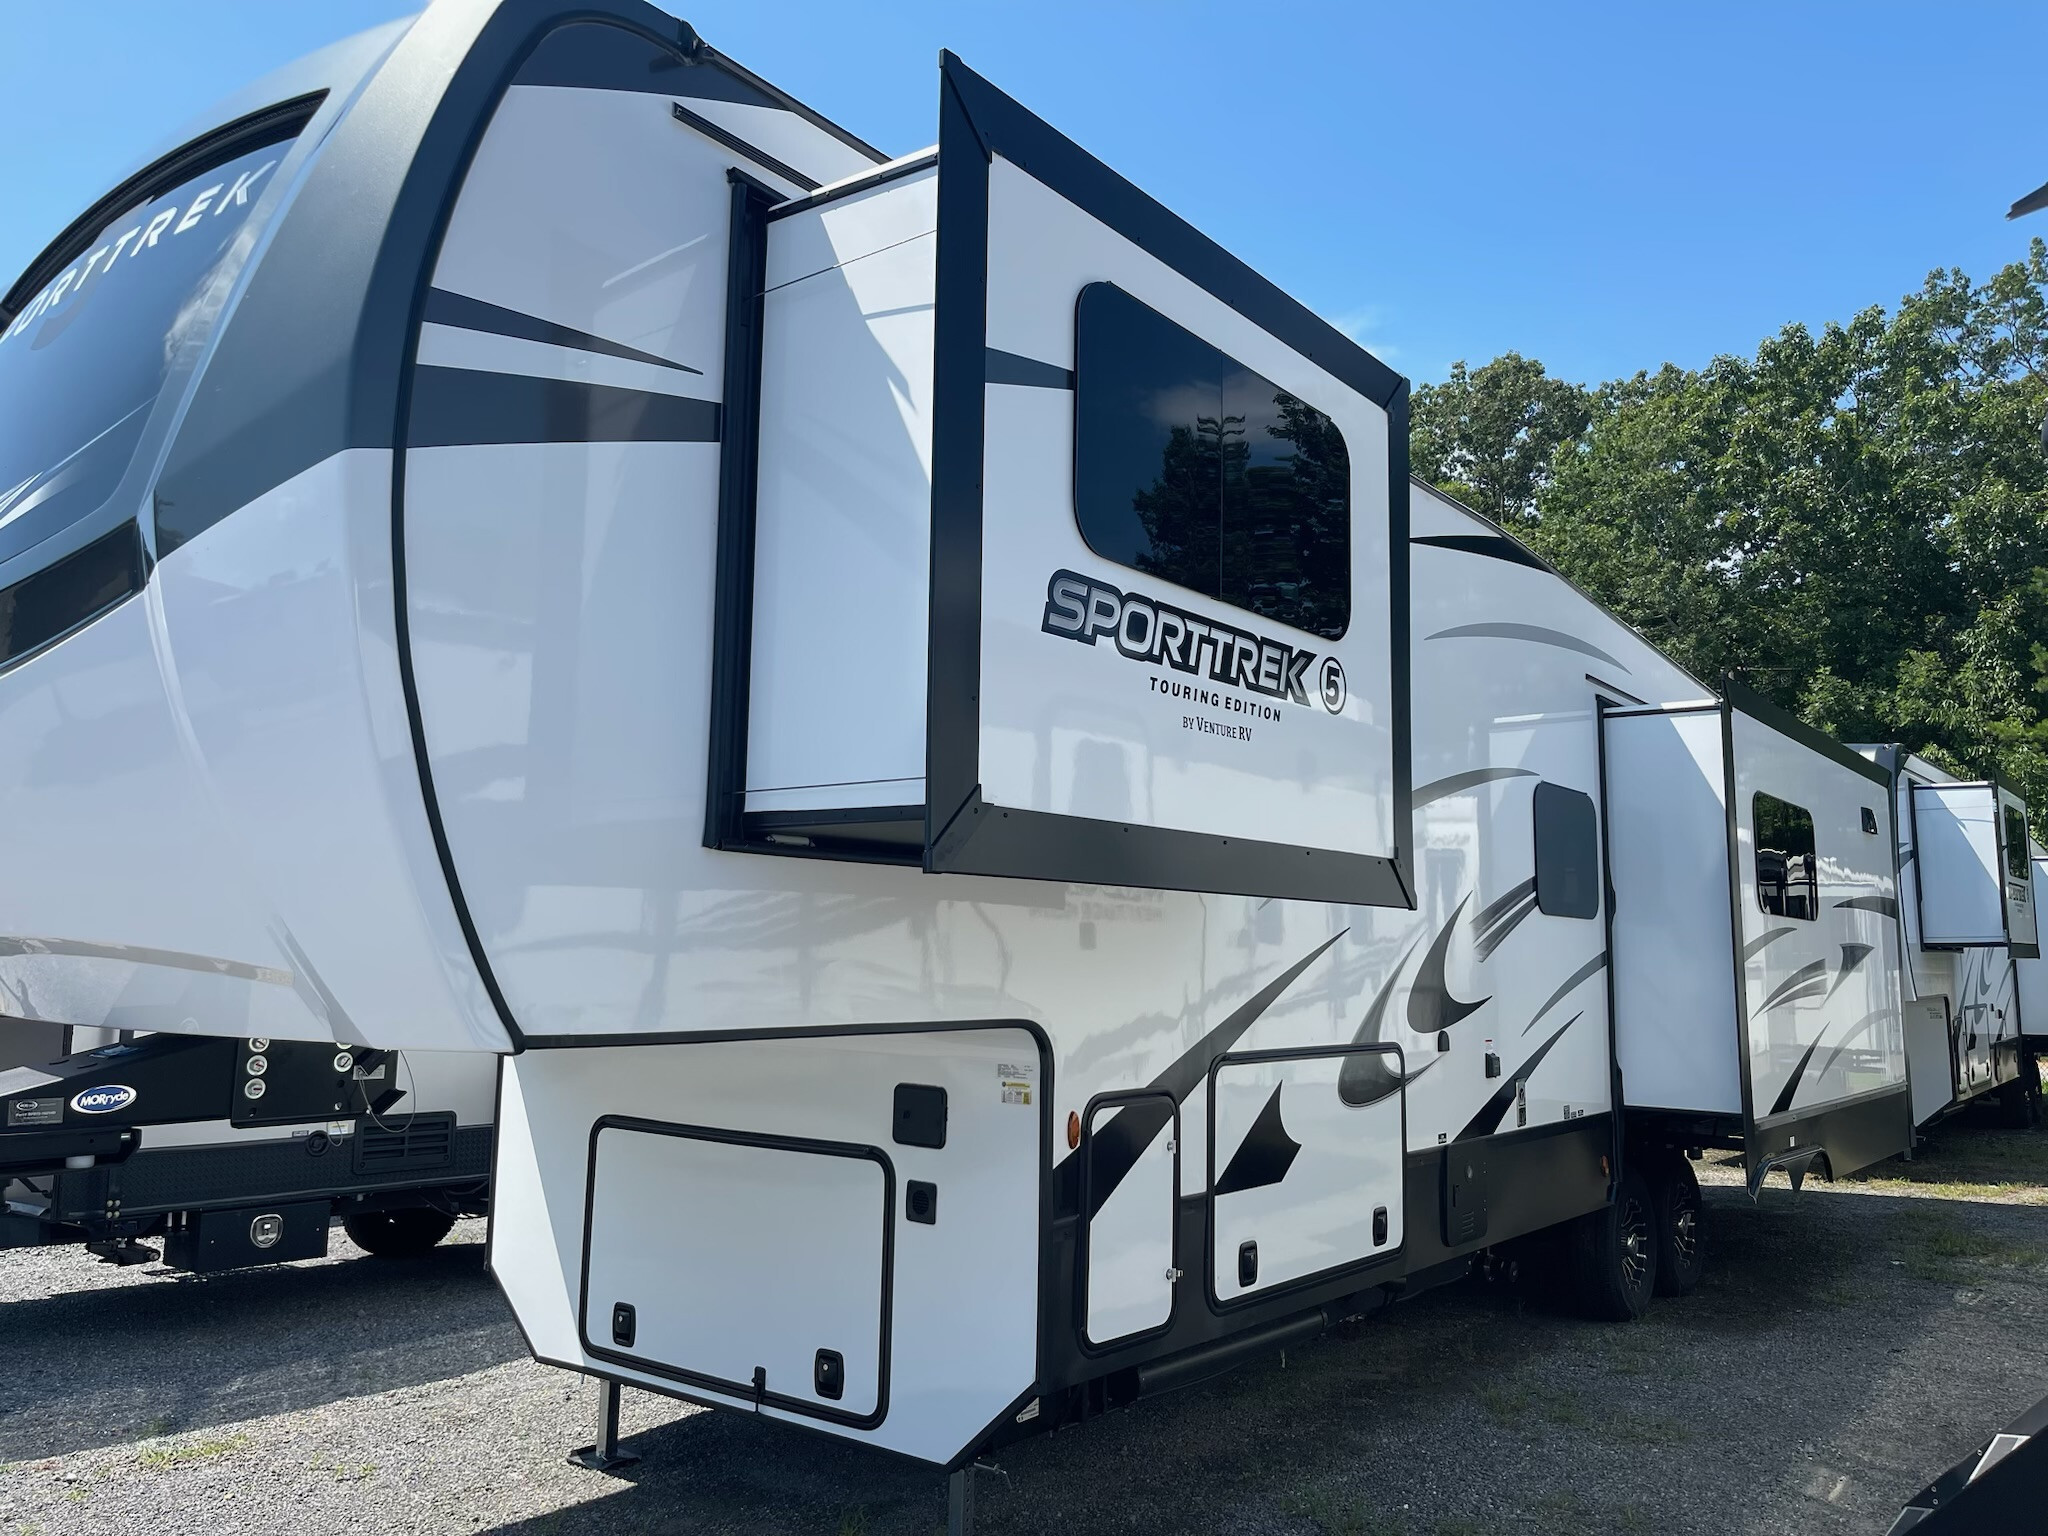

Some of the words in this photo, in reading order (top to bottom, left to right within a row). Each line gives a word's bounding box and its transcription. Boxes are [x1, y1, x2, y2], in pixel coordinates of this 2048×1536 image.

[1042, 569, 1317, 706] SPORTTREK
[1324, 662, 1342, 708] 5
[1150, 676, 1219, 707] TOURING
[1224, 696, 1281, 722] EDITION
[1182, 716, 1195, 730] BY
[1238, 725, 1252, 742] RV
